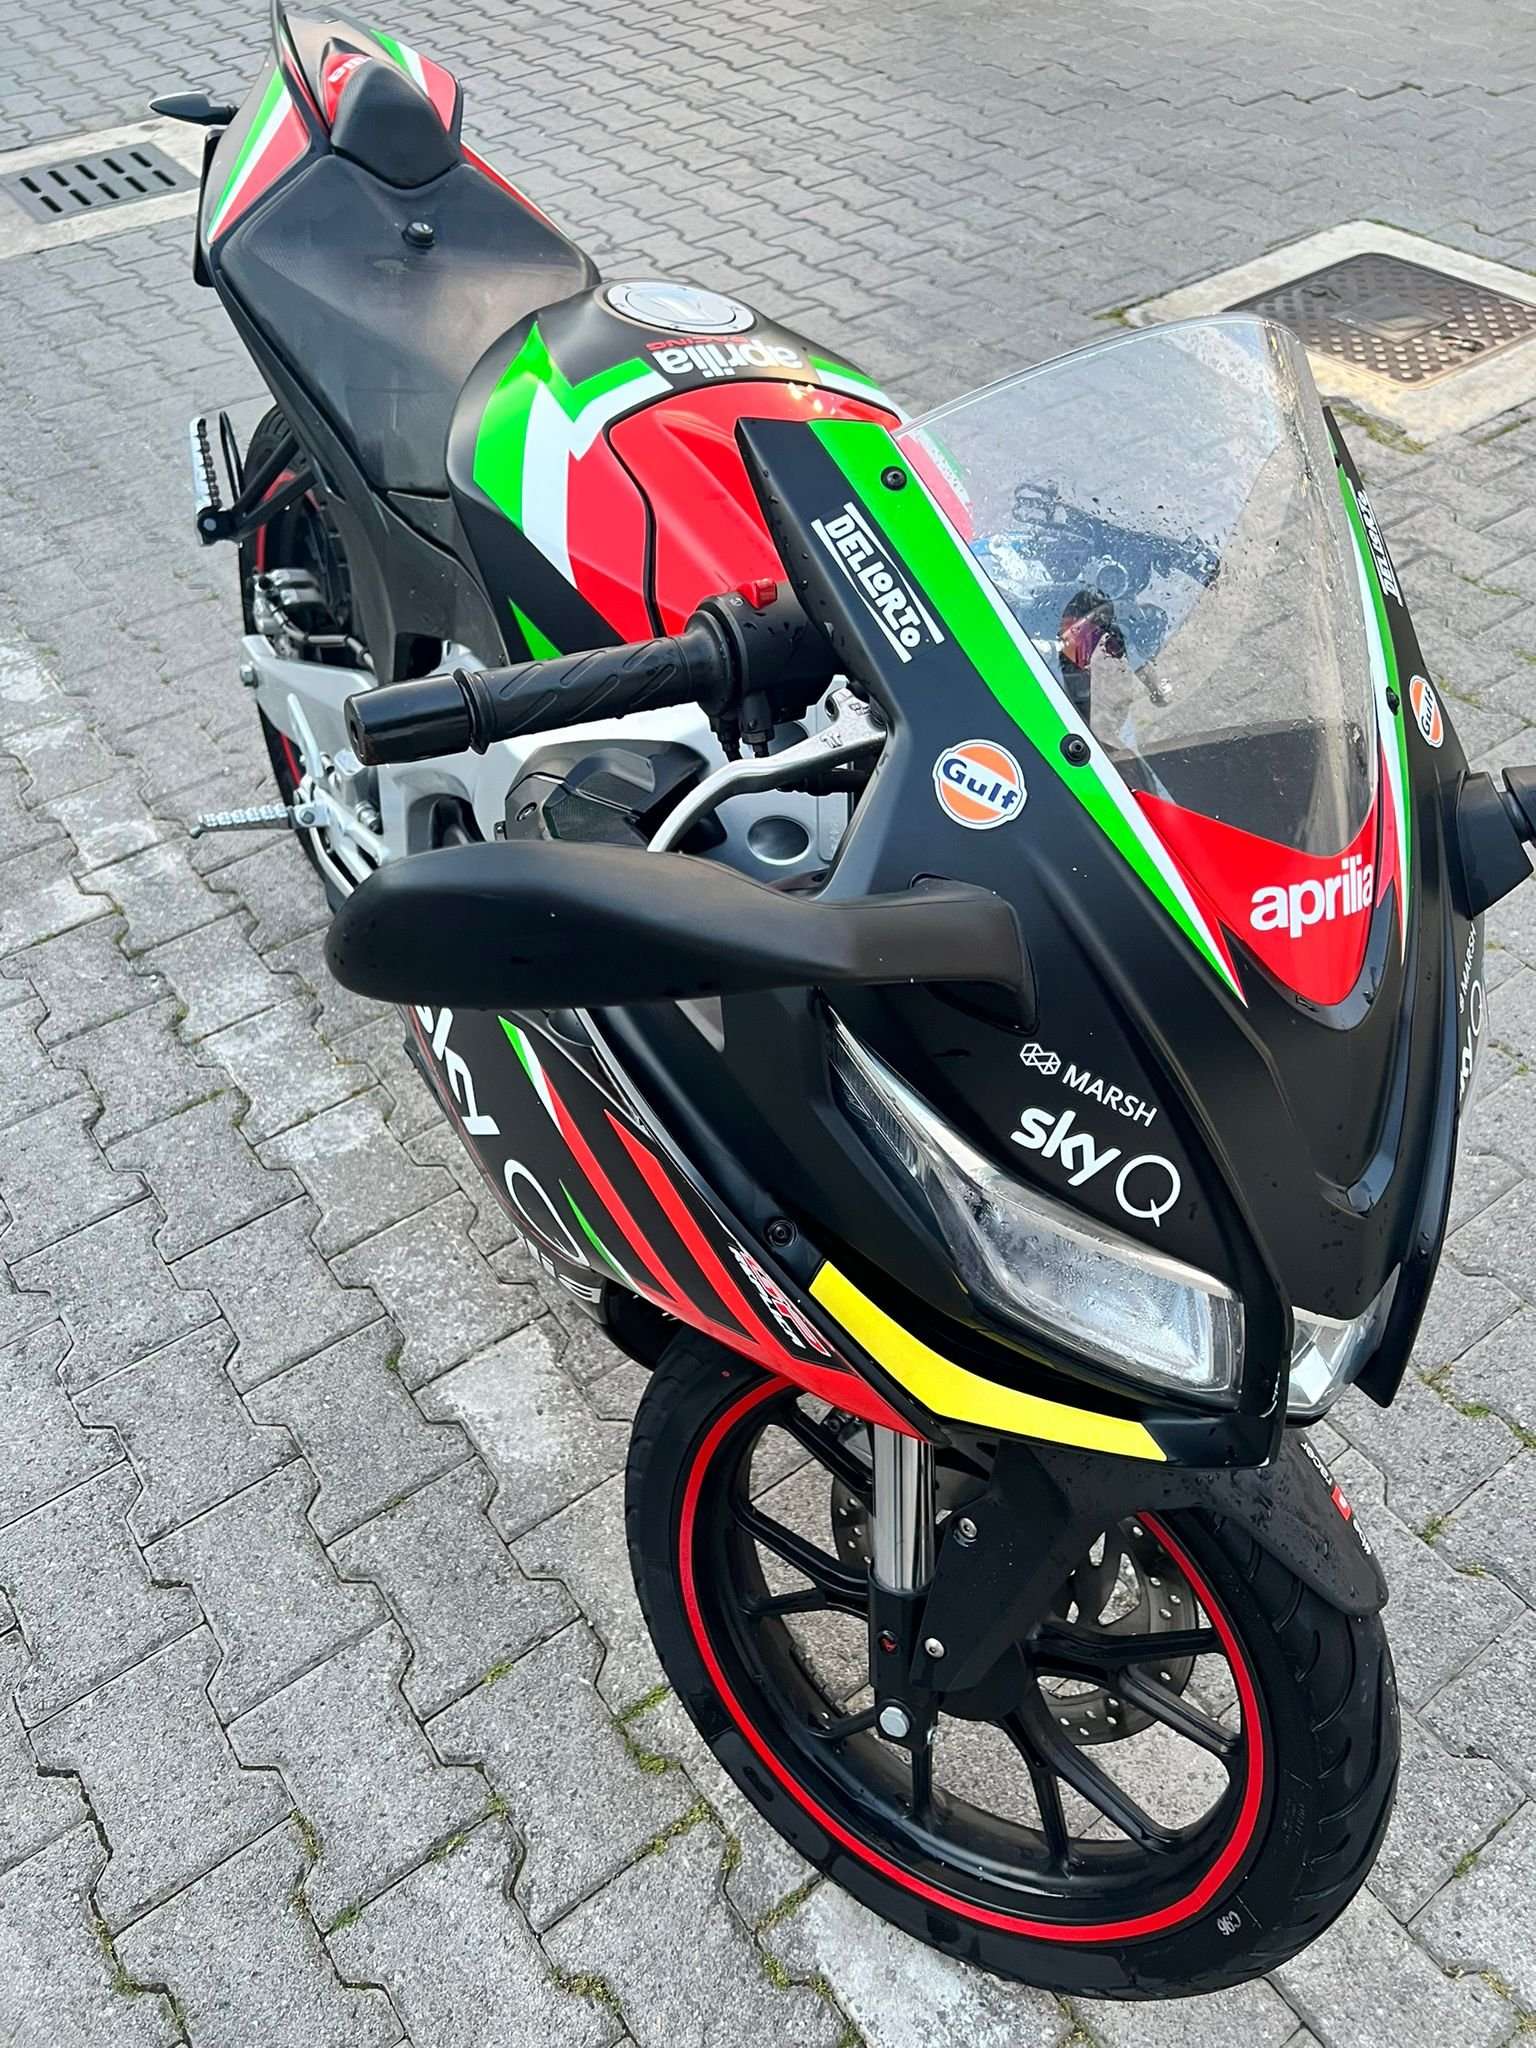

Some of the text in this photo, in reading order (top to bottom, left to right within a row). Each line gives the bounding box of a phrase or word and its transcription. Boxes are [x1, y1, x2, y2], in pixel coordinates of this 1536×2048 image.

[645, 335, 749, 351] RACING
[652, 338, 803, 378] aprilia
[823, 513, 921, 648] DELLORTO
[1421, 686, 1434, 737] Gulf
[942, 758, 1018, 810] Gulf
[1250, 853, 1374, 939] aprilia
[1062, 1064, 1158, 1128] MARSH
[1010, 1107, 1181, 1228] sky Q
[1300, 1441, 1333, 1486] racer
[1216, 1910, 1241, 1936] C96
